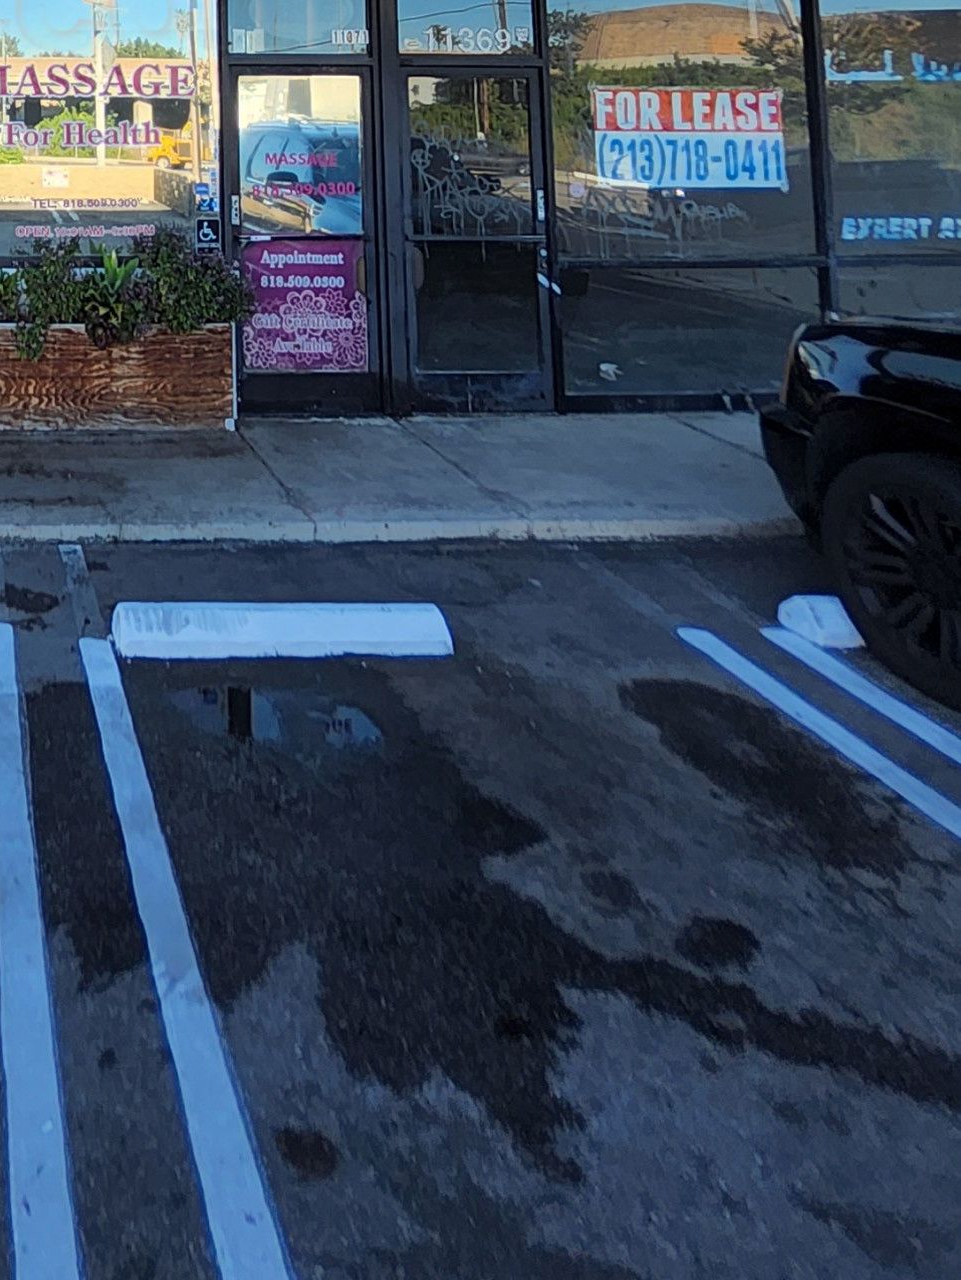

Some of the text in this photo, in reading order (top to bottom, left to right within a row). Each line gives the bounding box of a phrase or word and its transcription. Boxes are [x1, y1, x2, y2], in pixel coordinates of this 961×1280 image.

[423, 27, 511, 53] 11369
[595, 91, 779, 130] FOR LEASE
[4, 120, 161, 147] For Health
[265, 152, 337, 167] MASSAGE
[599, 133, 783, 185] (213)718-0411
[32, 199, 57, 209] TEL:
[15, 224, 51, 237] OPEN
[260, 249, 344, 268] Appointment
[252, 311, 353, 330] Gift Certificate
